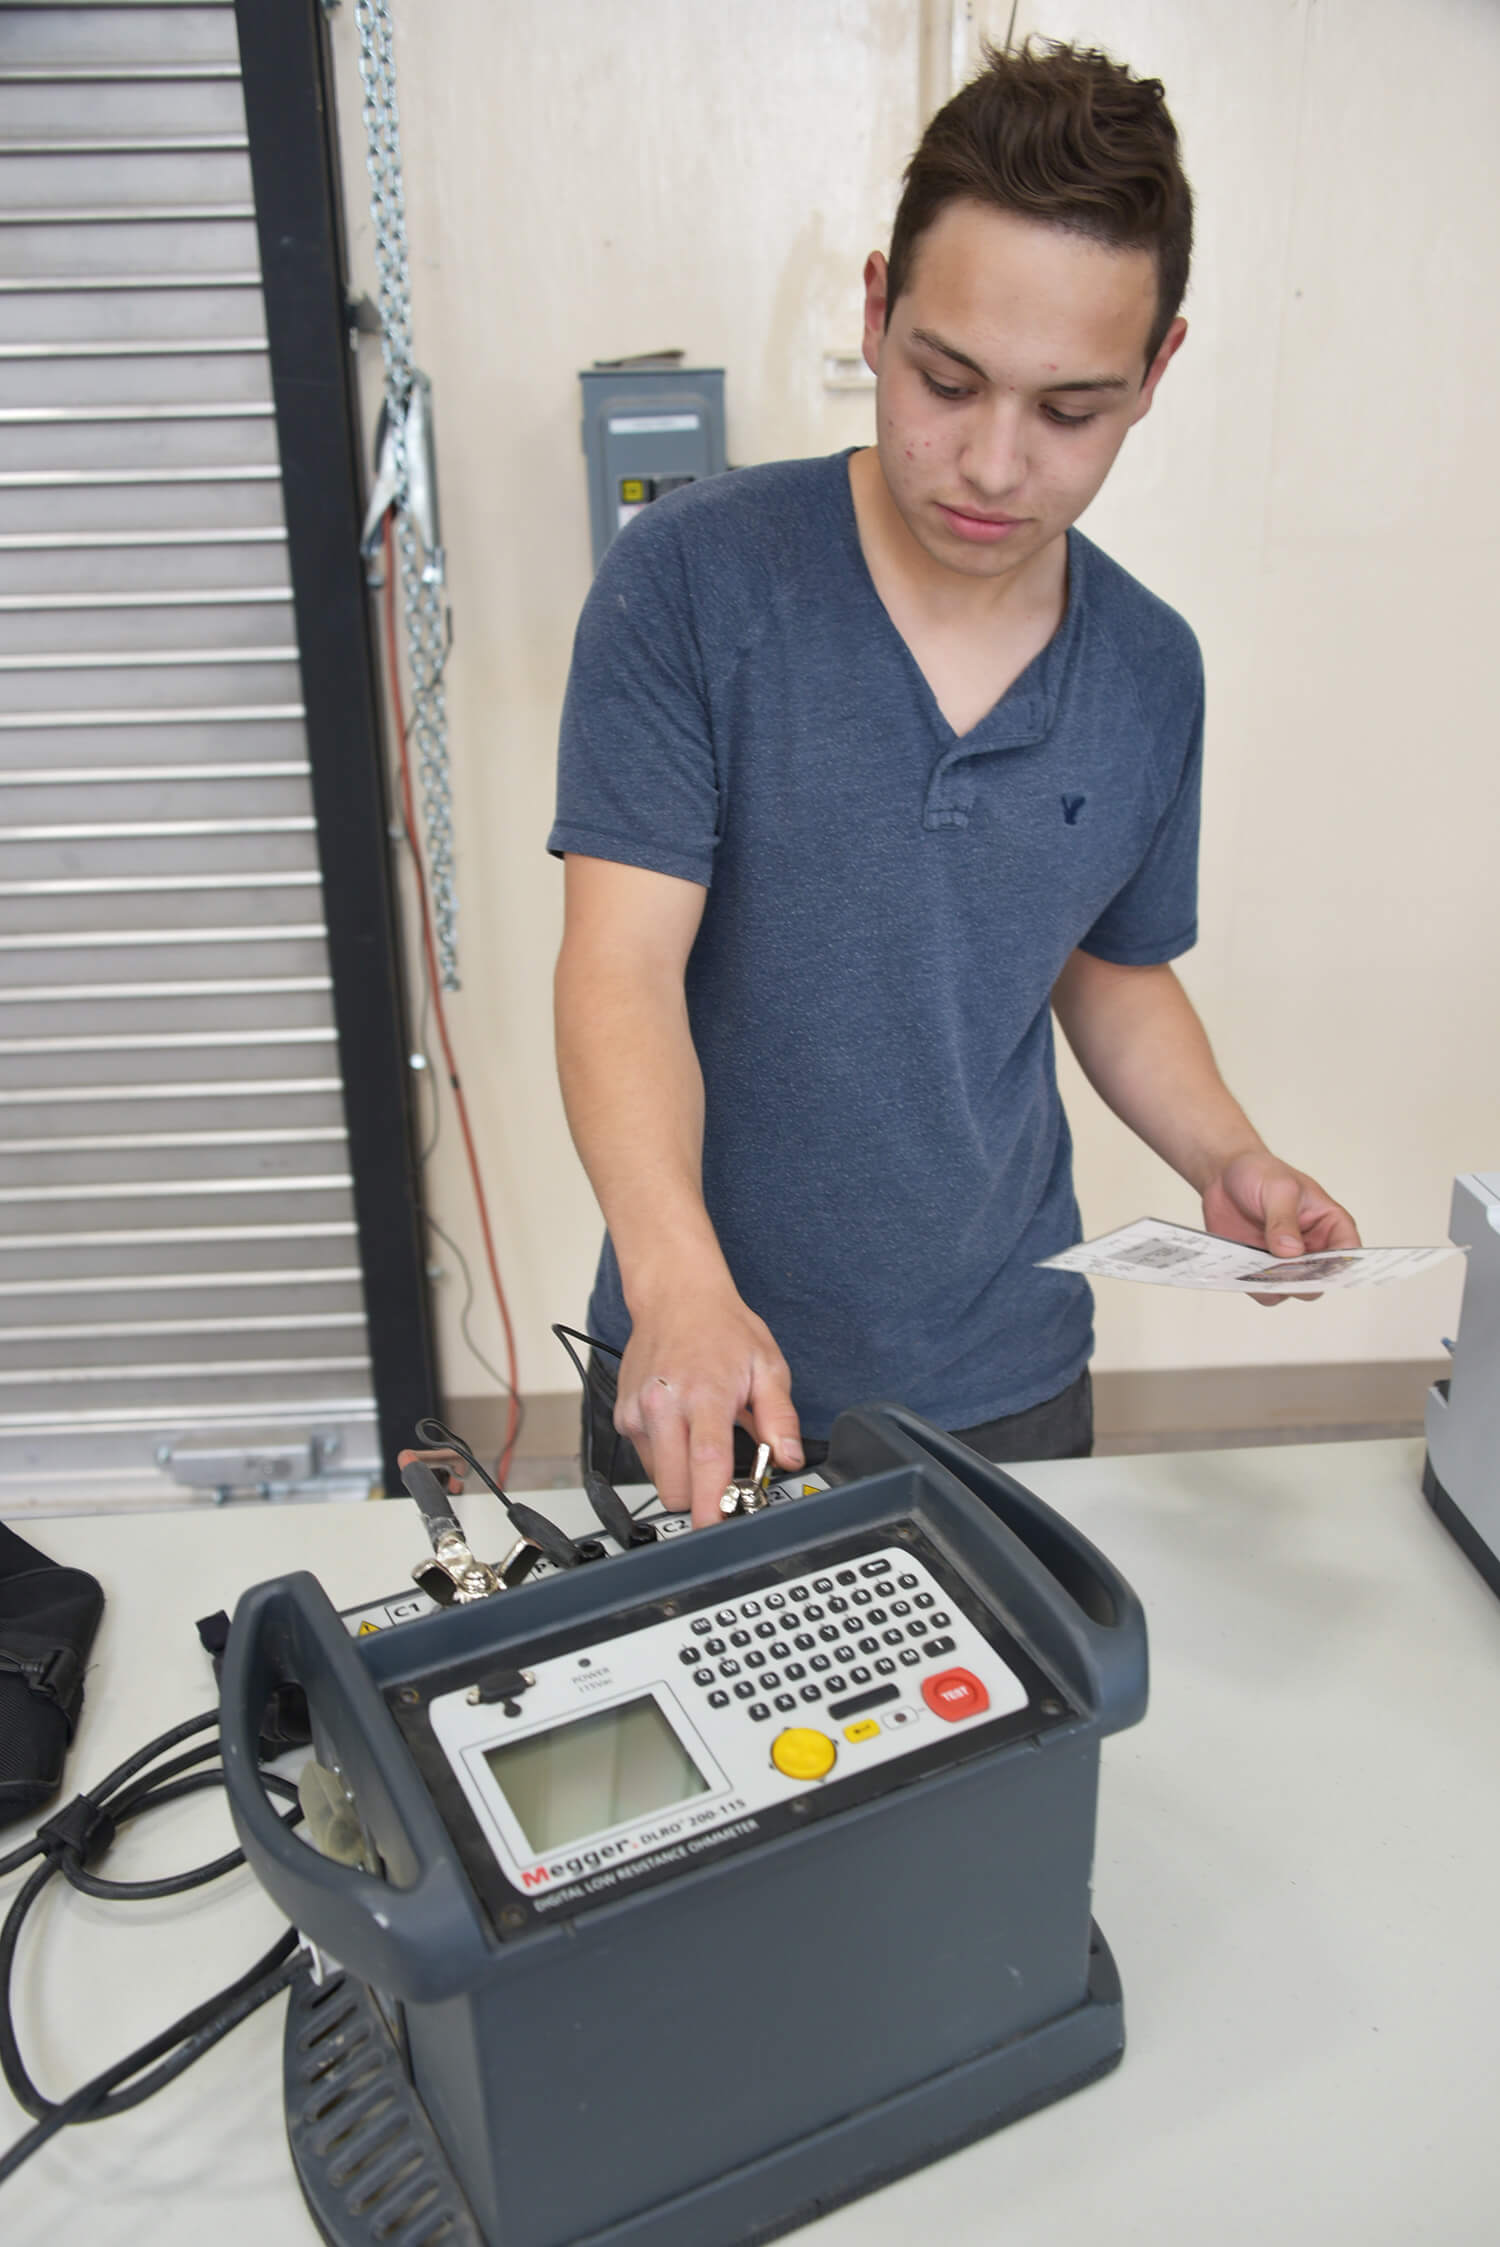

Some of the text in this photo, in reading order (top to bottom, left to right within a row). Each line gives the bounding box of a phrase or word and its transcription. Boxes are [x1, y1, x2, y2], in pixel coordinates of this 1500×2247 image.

[662, 1519, 689, 1533] C2
[393, 1602, 420, 1617] C1
[940, 1685, 970, 1703] TEST
[533, 1818, 760, 1912] DIGITAL LOW RESISTANCE OHMMETER
